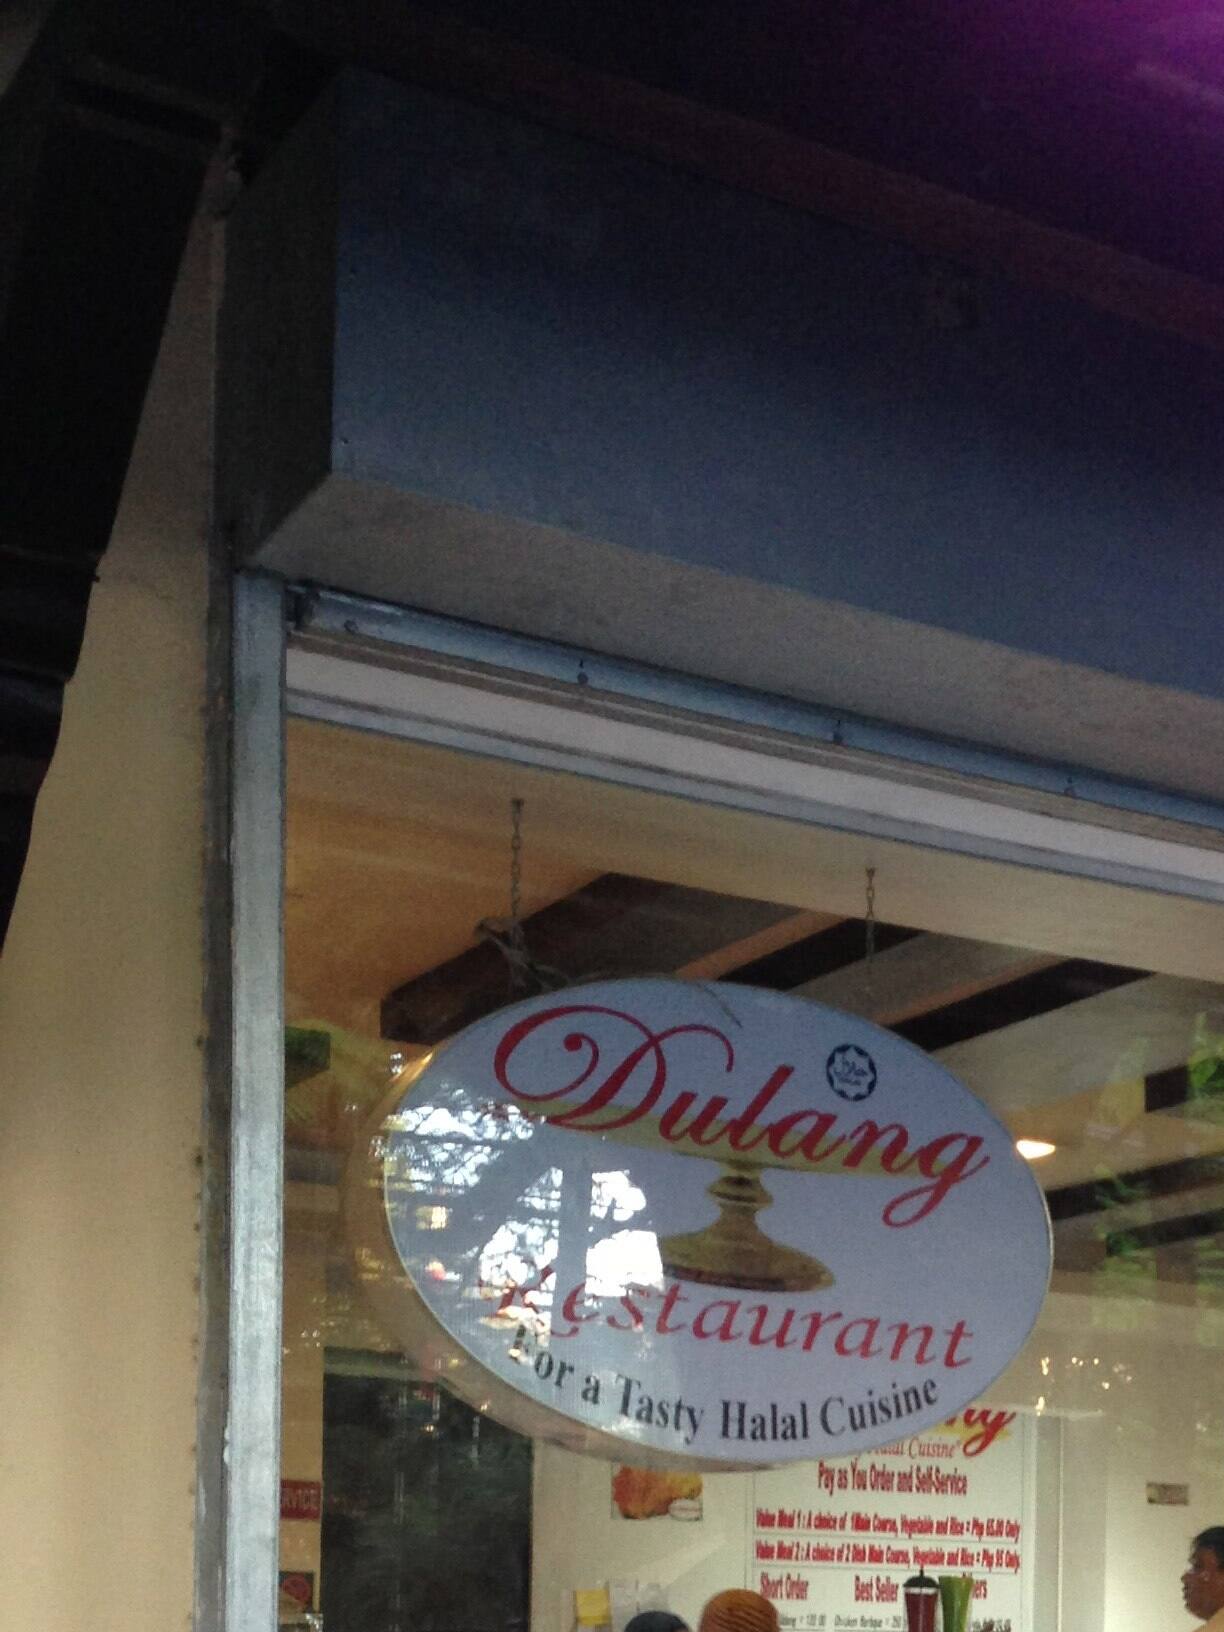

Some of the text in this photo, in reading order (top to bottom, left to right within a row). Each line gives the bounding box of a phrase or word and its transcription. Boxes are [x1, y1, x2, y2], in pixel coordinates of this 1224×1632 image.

[493, 1004, 993, 1229] Dulang
[581, 1375, 600, 1406] a
[615, 1373, 705, 1446] Tasty
[720, 1400, 809, 1442] Halal
[819, 1377, 939, 1437] Cuisine
[818, 1460, 835, 1496] Pay
[837, 1467, 848, 1490] as
[851, 1457, 867, 1491] You
[870, 1461, 895, 1493] Order
[897, 1464, 913, 1493] and
[855, 1574, 899, 1602] Best Seller
